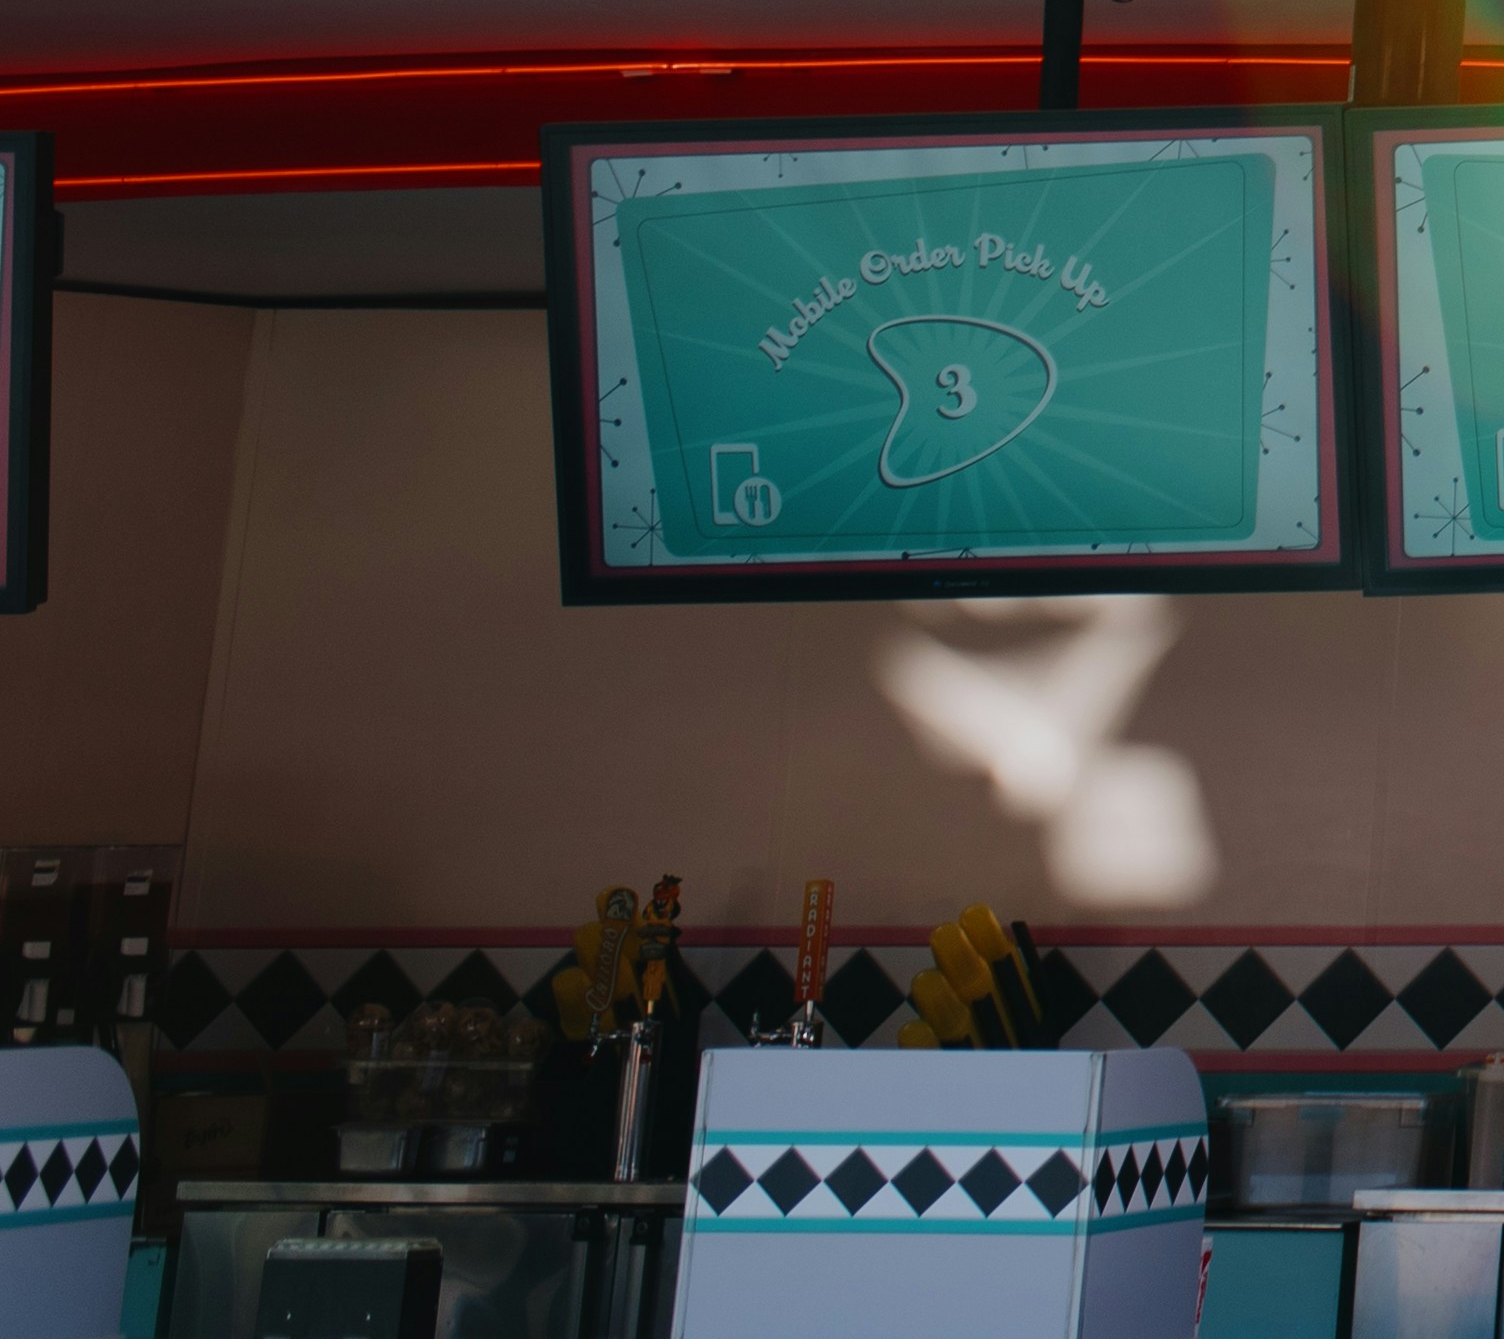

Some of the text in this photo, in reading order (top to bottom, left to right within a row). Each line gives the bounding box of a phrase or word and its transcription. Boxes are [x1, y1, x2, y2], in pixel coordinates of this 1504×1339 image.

[758, 233, 1110, 372] Mobile Order Pick Up
[936, 363, 977, 419] 3
[801, 892, 818, 998] RADIANT
